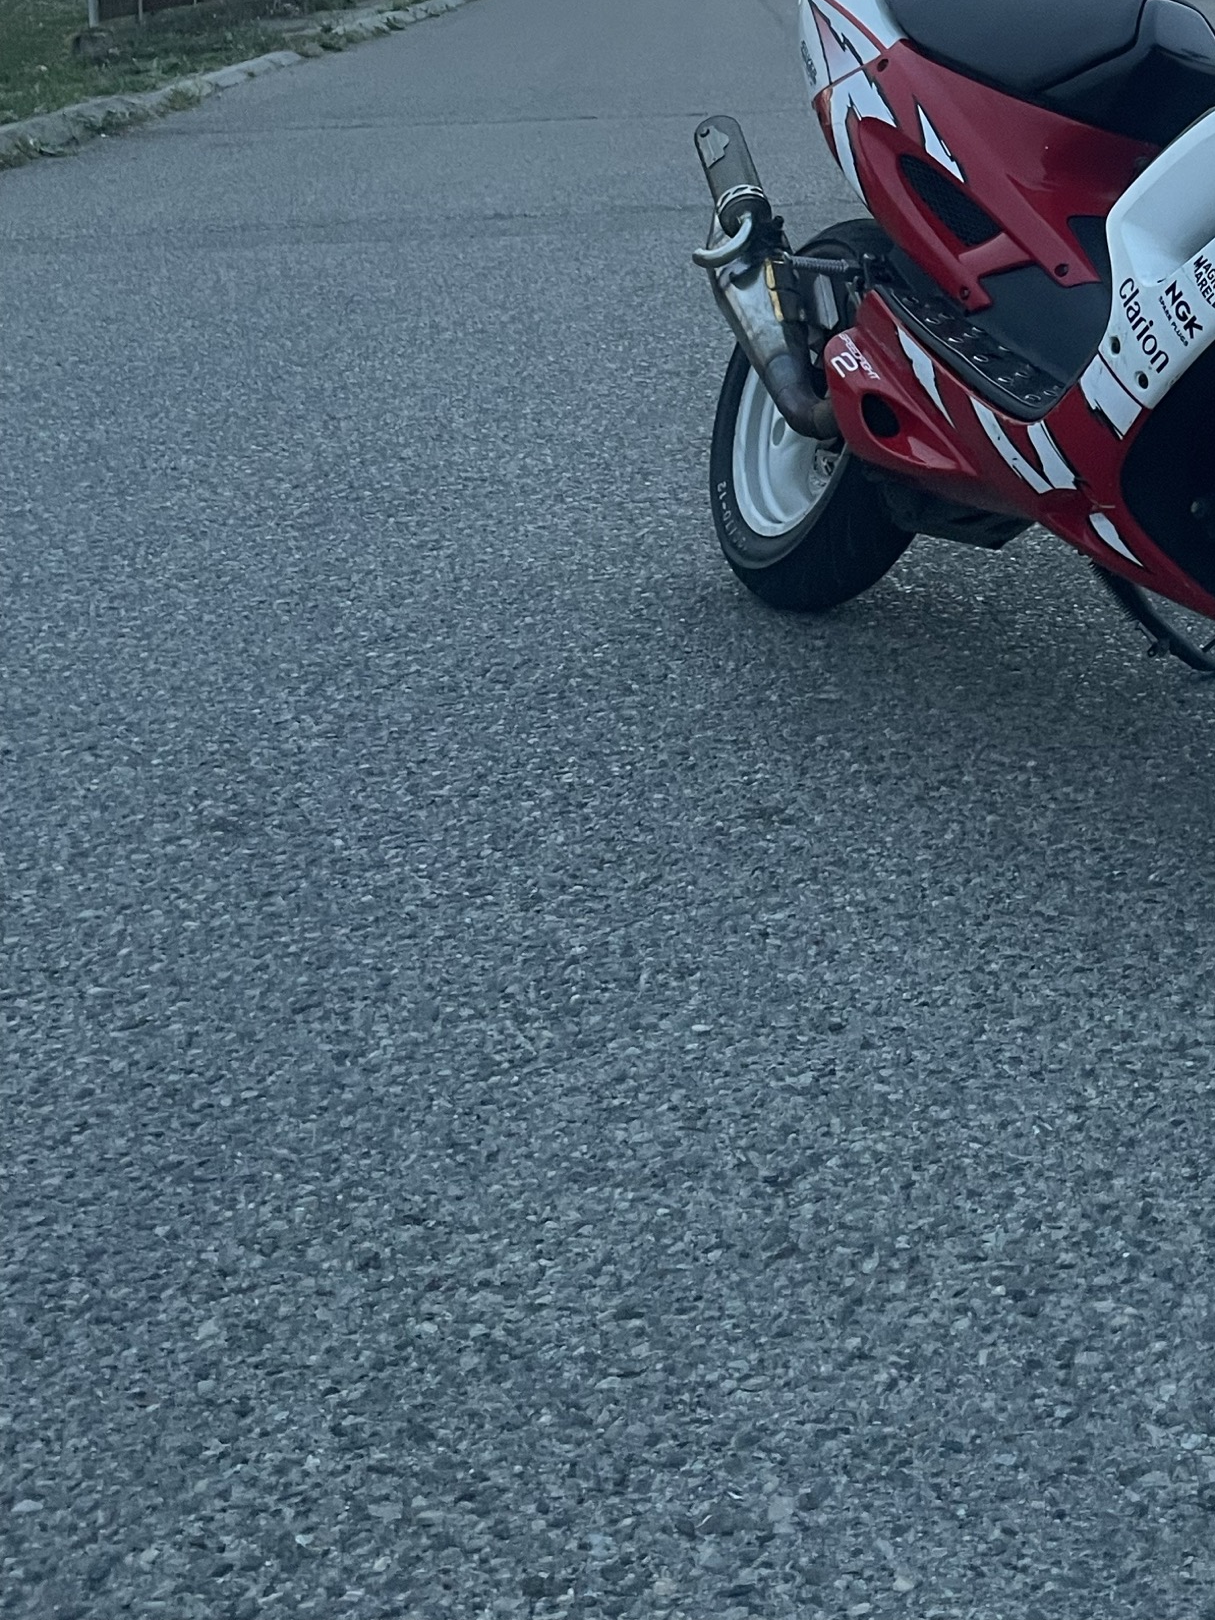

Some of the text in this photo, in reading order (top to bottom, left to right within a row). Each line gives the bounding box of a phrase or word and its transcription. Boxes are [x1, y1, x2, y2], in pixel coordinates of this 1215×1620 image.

[1119, 277, 1169, 374] Clarion
[1159, 295, 1189, 347] SPARK PLUGS
[1164, 279, 1203, 339] NGK
[830, 351, 859, 378] 2
